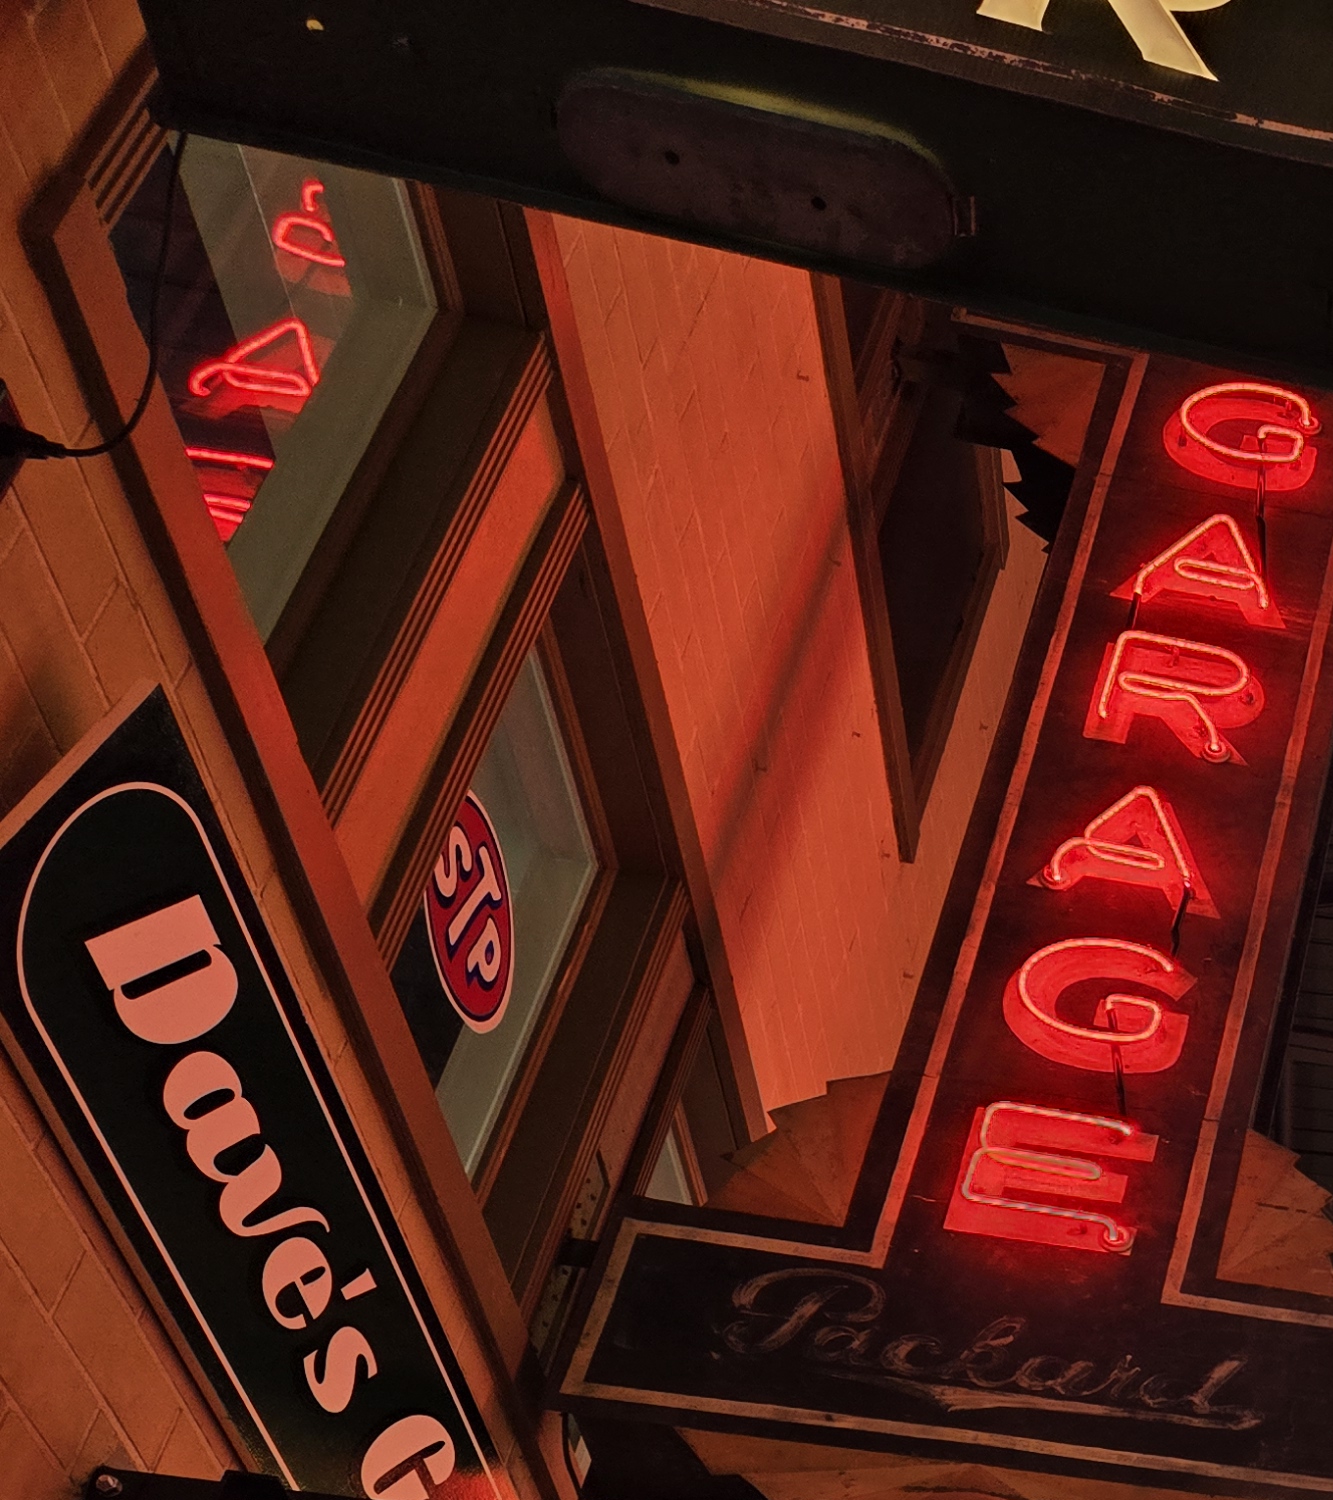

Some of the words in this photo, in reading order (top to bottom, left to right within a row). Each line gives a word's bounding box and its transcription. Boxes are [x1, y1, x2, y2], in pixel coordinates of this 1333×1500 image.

[434, 822, 503, 987] STP
[943, 382, 1322, 1256] GARAGE
[85, 894, 379, 1413] Dave's
[712, 1266, 1265, 1432] Packard
